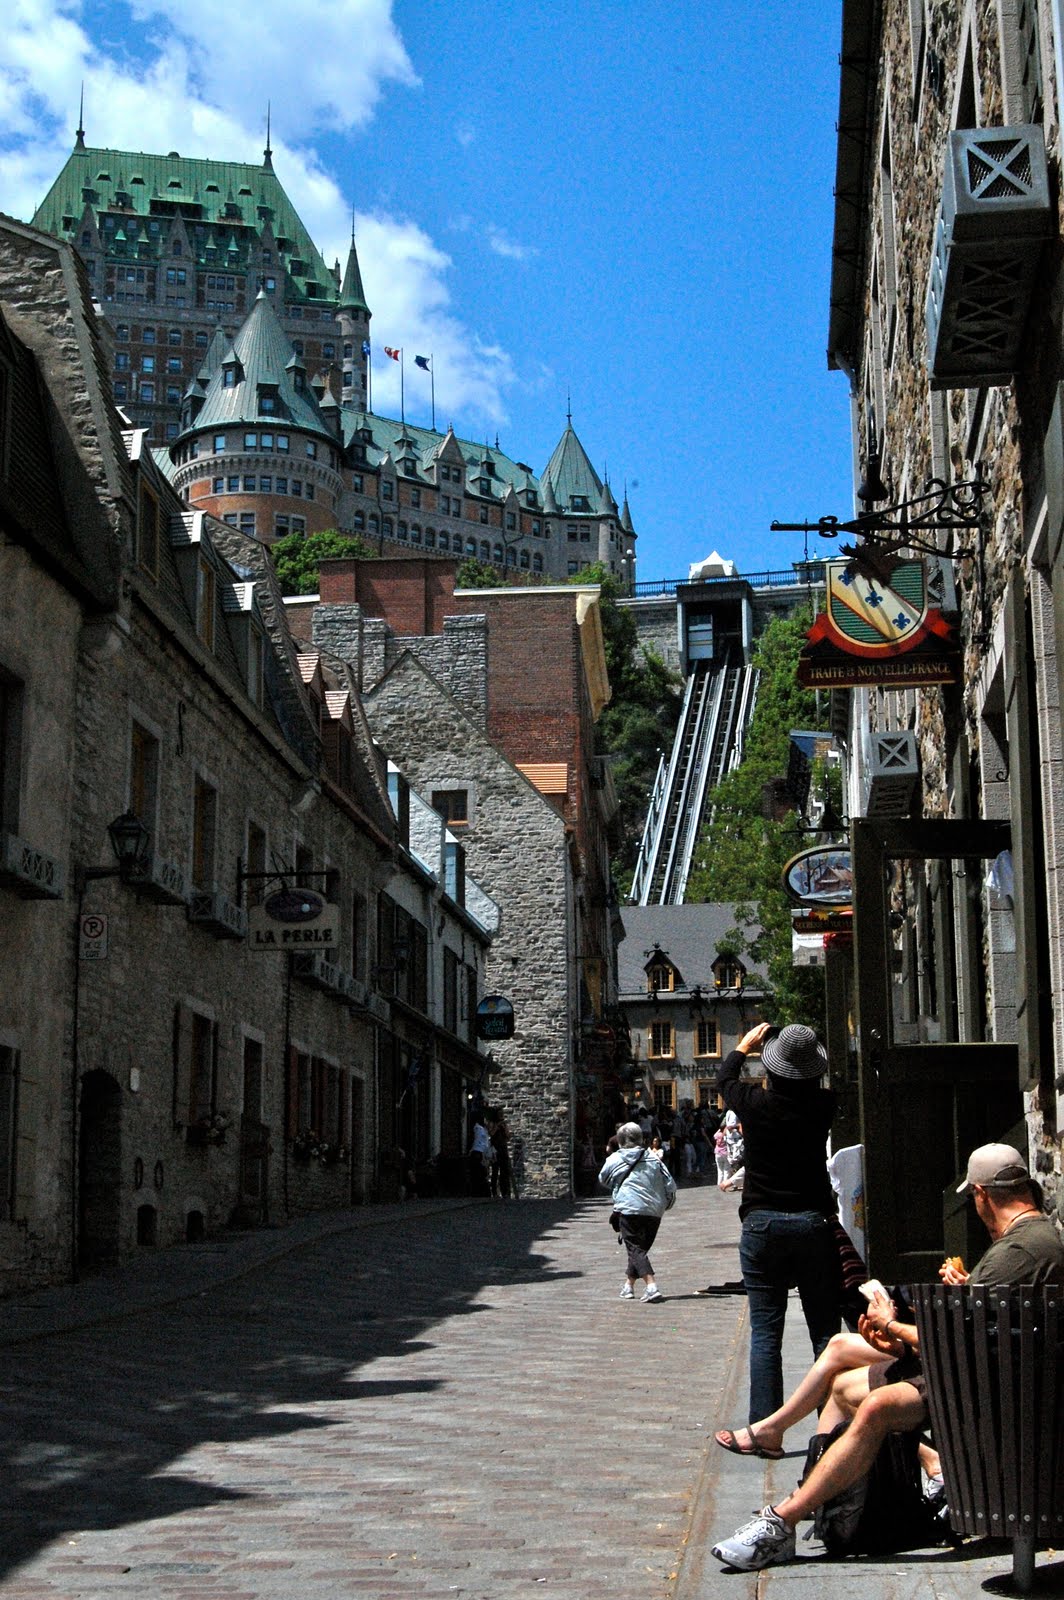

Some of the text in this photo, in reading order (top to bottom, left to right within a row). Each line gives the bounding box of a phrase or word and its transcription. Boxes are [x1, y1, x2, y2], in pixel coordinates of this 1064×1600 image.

[809, 666, 845, 679] TRAITE
[857, 662, 951, 677] NOUVELLE-FRANCE
[255, 928, 333, 943] LA PERLE
